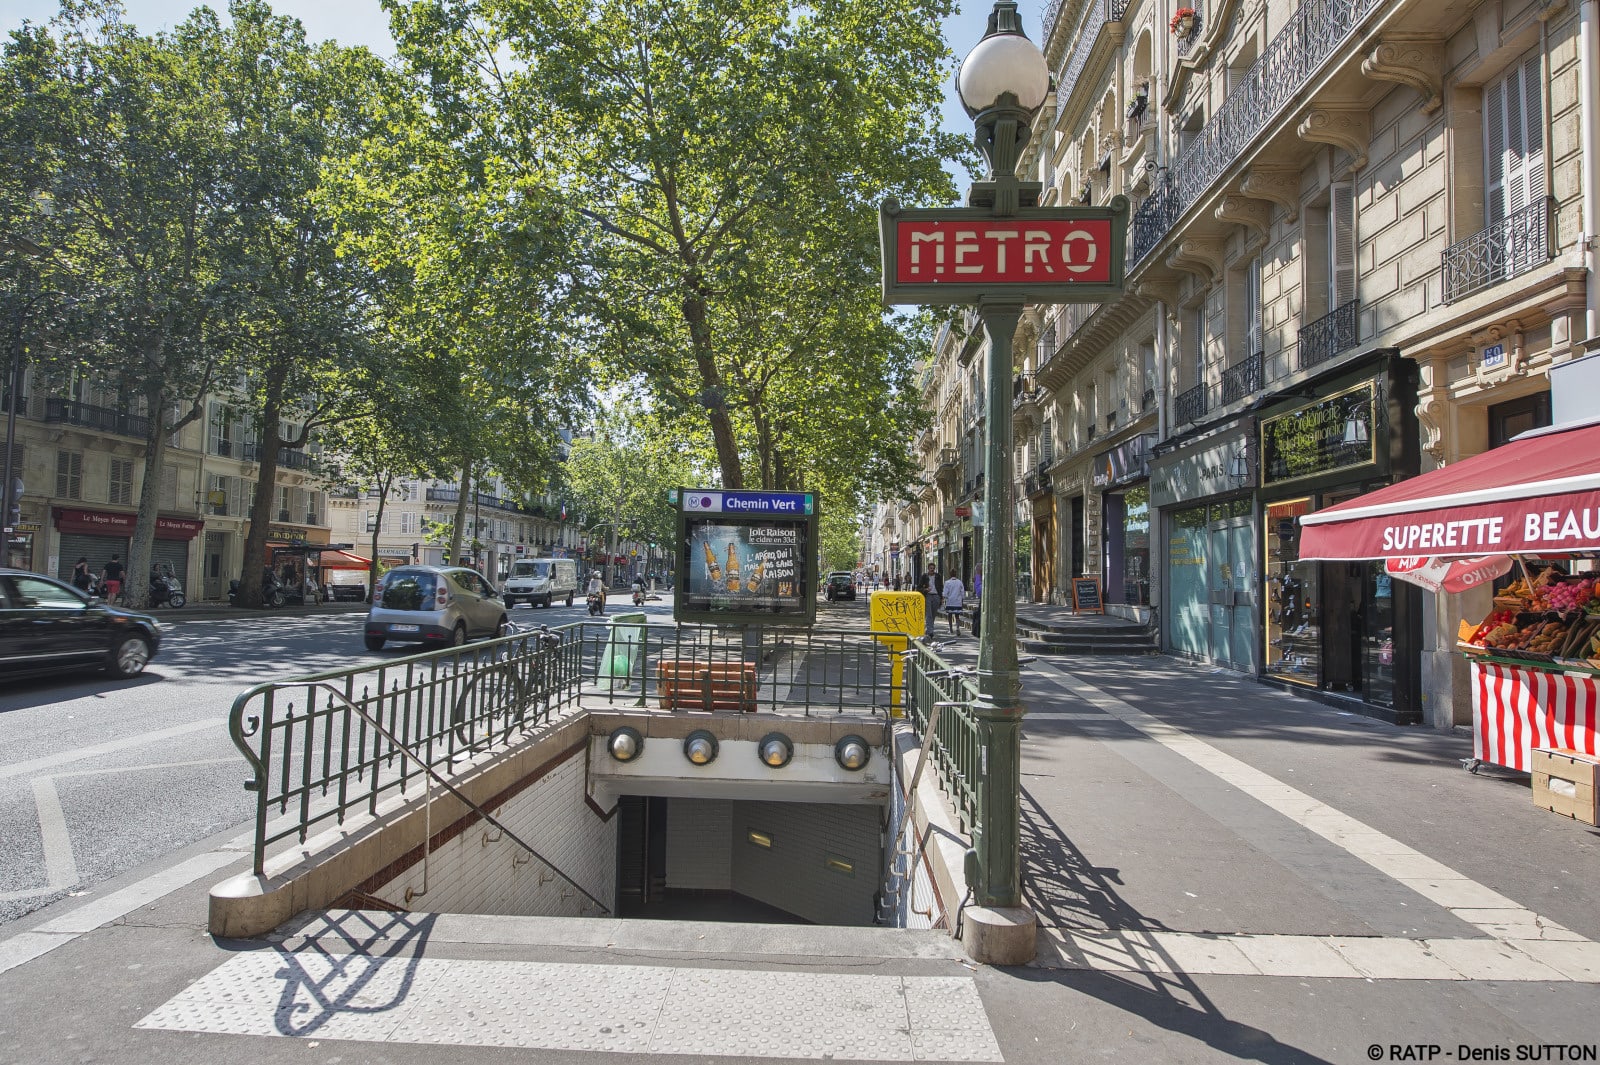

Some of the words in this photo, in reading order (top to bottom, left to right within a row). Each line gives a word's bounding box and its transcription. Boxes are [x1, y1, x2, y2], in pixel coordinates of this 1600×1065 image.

[911, 230, 1097, 274] METRO
[1485, 346, 1502, 365] 59
[726, 498, 768, 509] Chemin
[772, 499, 796, 510] Vert
[749, 528, 766, 536] Loïc
[766, 528, 796, 537] Raison
[1382, 516, 1504, 551] SUPERETTE
[1523, 507, 1600, 542] BEAU
[776, 560, 793, 568] SANS
[762, 569, 794, 579] RAISON
